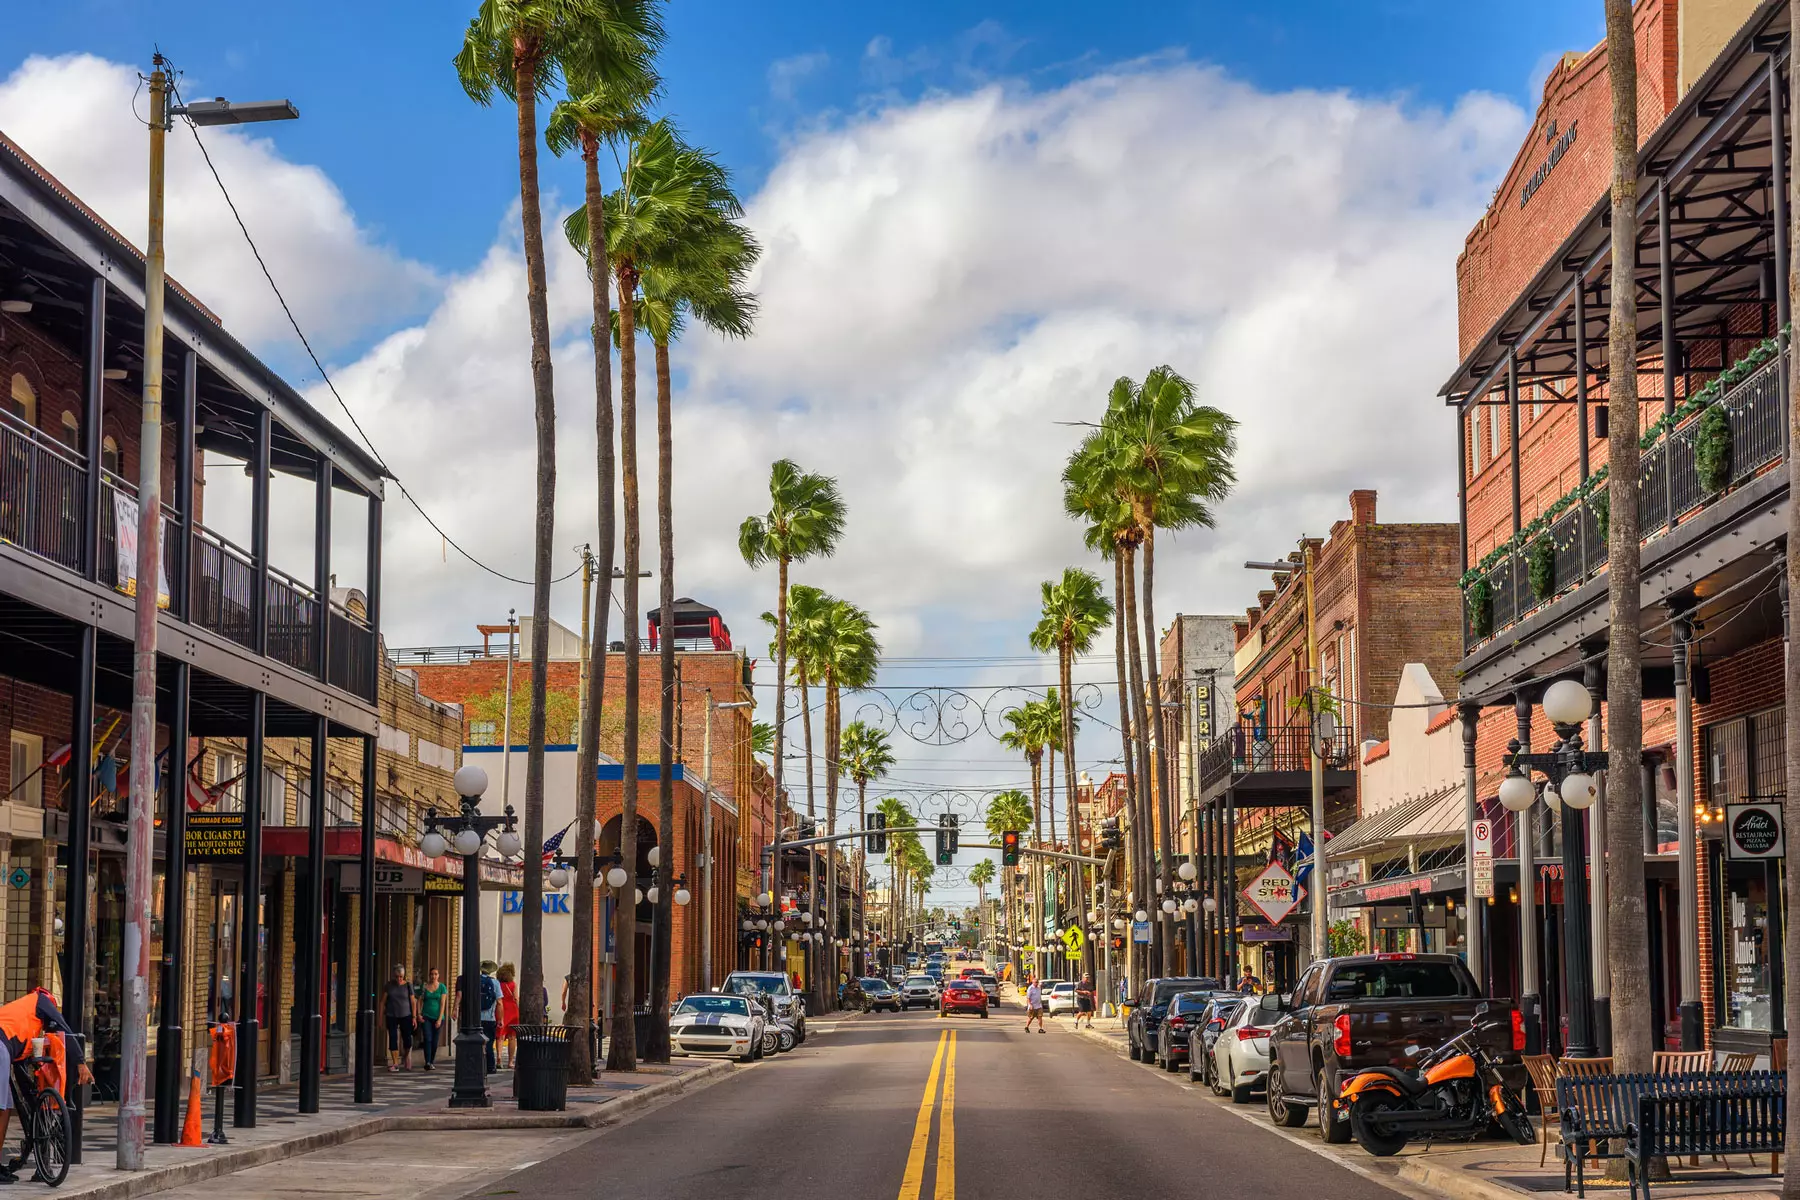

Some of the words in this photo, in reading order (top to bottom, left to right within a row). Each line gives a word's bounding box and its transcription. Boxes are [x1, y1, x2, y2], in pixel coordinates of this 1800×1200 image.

[1547, 119, 1577, 177] BUILDING
[190, 816, 220, 824] HANDMADE
[221, 816, 242, 824] CIGARS
[185, 830, 202, 840] BOR
[203, 830, 232, 840] CIGARS
[198, 840, 227, 848] MOJITOS
[375, 871, 403, 883] UB
[1258, 888, 1292, 897] STR
[1734, 930, 1755, 964] Amici
